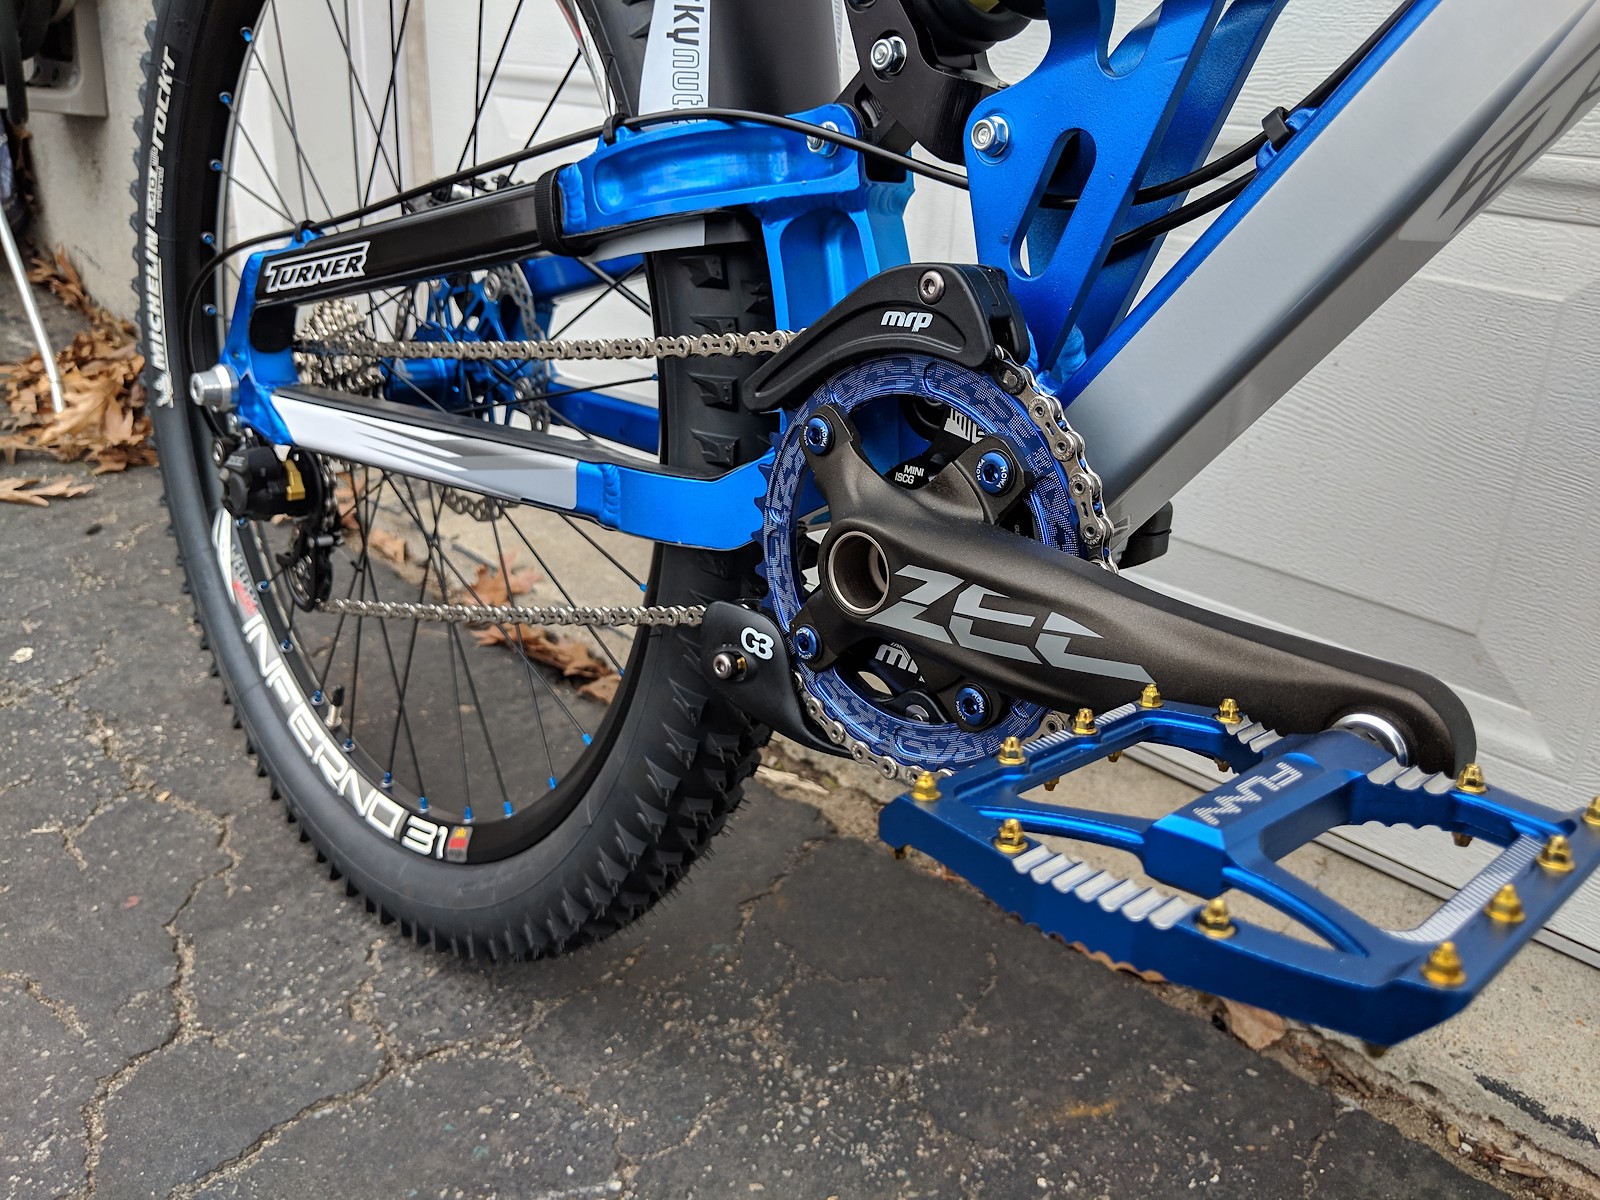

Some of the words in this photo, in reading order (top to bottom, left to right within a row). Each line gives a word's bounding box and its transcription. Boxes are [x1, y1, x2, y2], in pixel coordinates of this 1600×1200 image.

[264, 241, 371, 293] TURNER
[145, 225, 166, 371] MICHELIN
[880, 311, 934, 332] mrp
[894, 472, 915, 485] ISCG
[903, 464, 925, 477] MINI
[740, 626, 775, 660] G3
[241, 613, 409, 840] INFERNO
[401, 814, 449, 860] 31
[1192, 761, 1304, 827] FUNN
